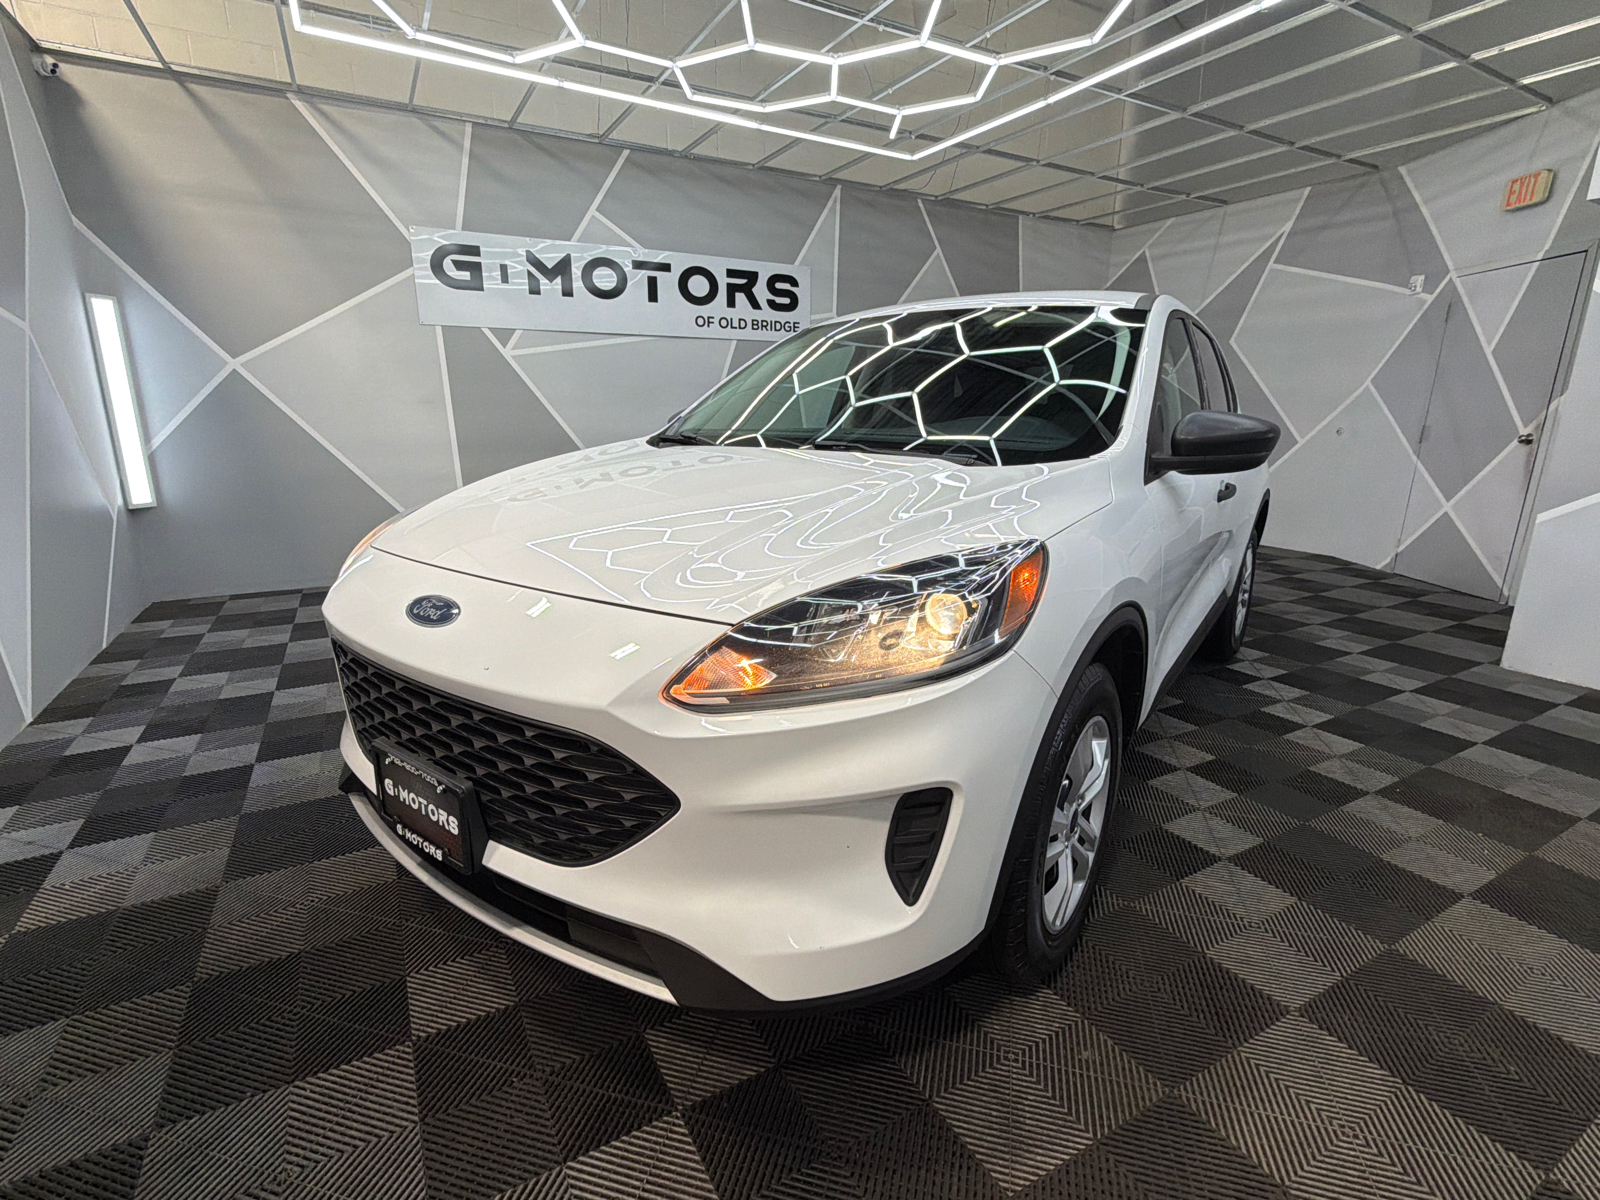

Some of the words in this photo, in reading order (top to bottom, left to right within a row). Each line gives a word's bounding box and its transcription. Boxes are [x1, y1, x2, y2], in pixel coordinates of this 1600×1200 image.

[1506, 171, 1542, 208] EXIT
[694, 315, 715, 329] OF
[718, 316, 748, 331] OLD
[751, 318, 800, 333] BRIDGE
[413, 599, 447, 620] Ford
